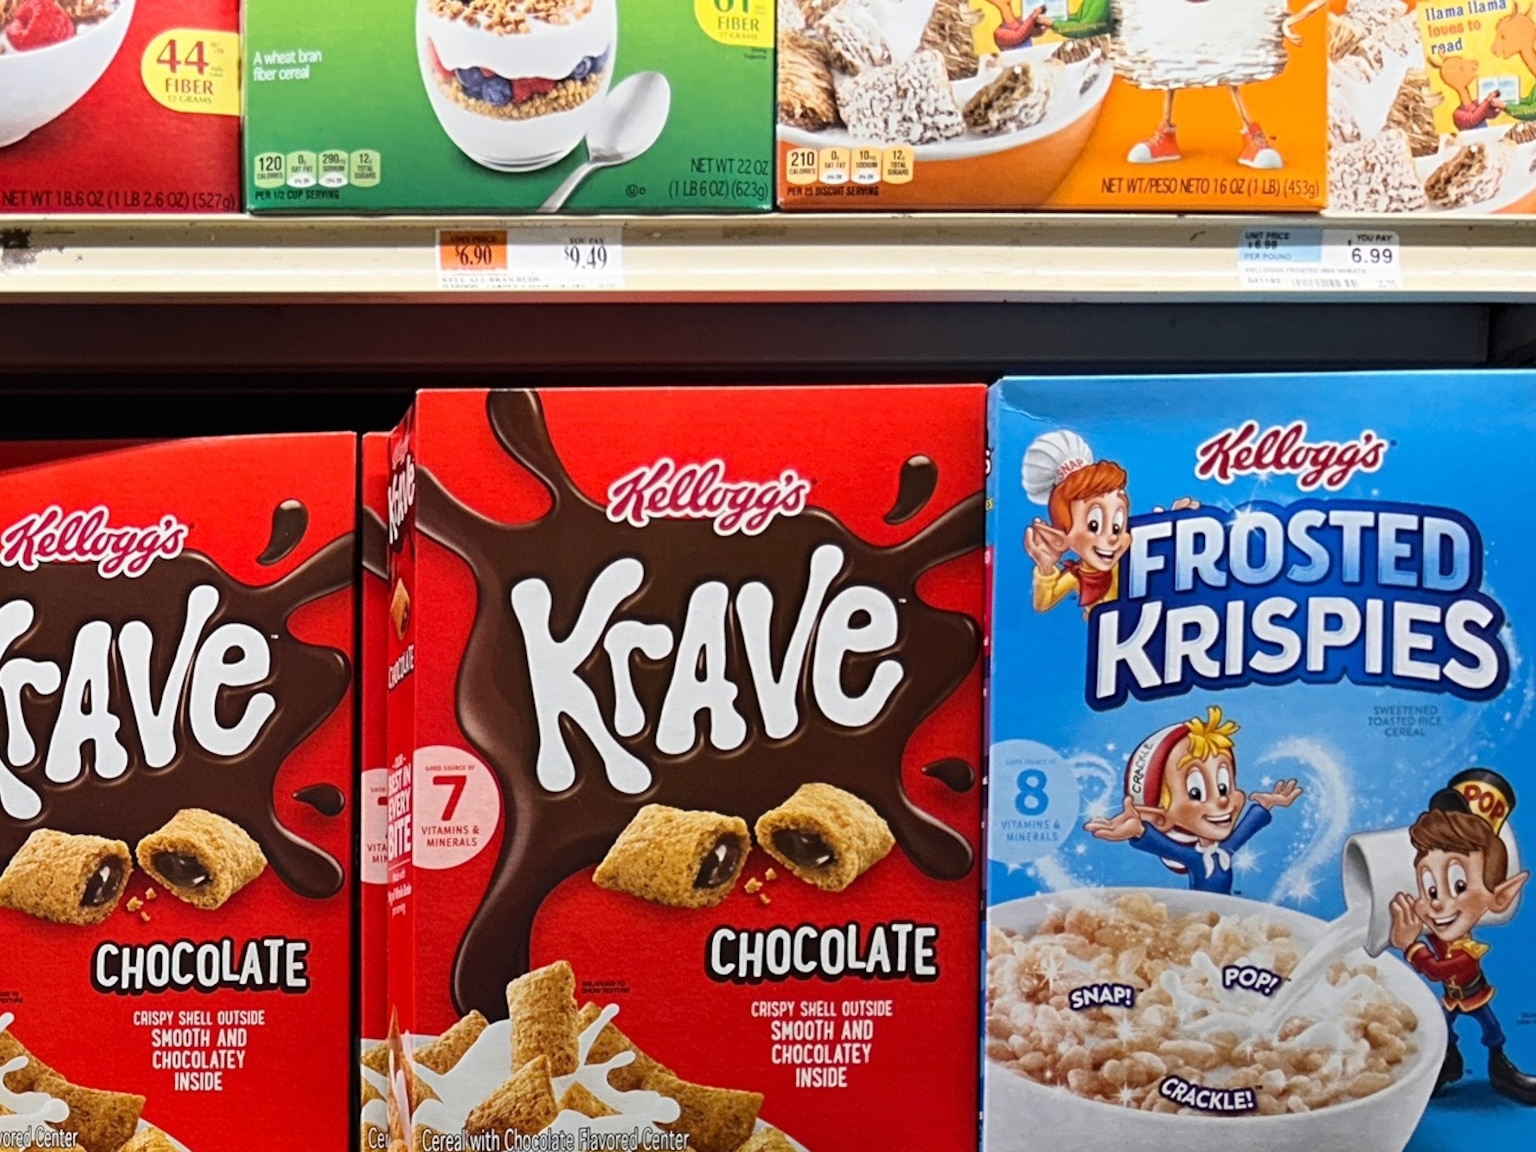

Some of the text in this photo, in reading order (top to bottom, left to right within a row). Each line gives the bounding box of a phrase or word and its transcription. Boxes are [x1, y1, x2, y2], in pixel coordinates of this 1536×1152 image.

[1425, 0, 1506, 21] llama llama
[717, 17, 760, 33] FIBER
[1428, 21, 1481, 37] loves to
[1431, 38, 1463, 54] read
[263, 51, 296, 66] wheat
[296, 49, 322, 64] bran
[253, 65, 310, 81] fiber cereal
[164, 78, 213, 95] FIBER
[690, 159, 770, 174] NET WT 22 OZ
[1101, 178, 1123, 194] NET
[1180, 178, 1209, 194] NETO
[1212, 177, 1227, 194] 16
[1230, 177, 1245, 194] OZ
[1262, 177, 1281, 197] LB)
[1284, 177, 1319, 198] (453g)
[1196, 420, 1389, 491] Kellogg's
[608, 460, 809, 534] Kellogg's
[3, 509, 188, 577] Kellogg's
[1129, 509, 1471, 599] FROSTED
[1096, 597, 1499, 699] KRISPIES
[1014, 769, 1049, 815] 8
[710, 924, 938, 976] CHOCOLATE
[96, 941, 308, 988] CHOCOLATE
[1224, 967, 1278, 993] POP!
[1070, 988, 1133, 1008] SNAP!
[133, 1010, 265, 1026] CRISPY SHELL OUTSIDE
[152, 1029, 247, 1048] SMOOTH AND
[152, 1050, 245, 1070] CHOCOLATEY
[174, 1072, 222, 1091] INSIDE
[1161, 1079, 1253, 1110] CRACKLE!
[36, 1128, 78, 1148] Center
